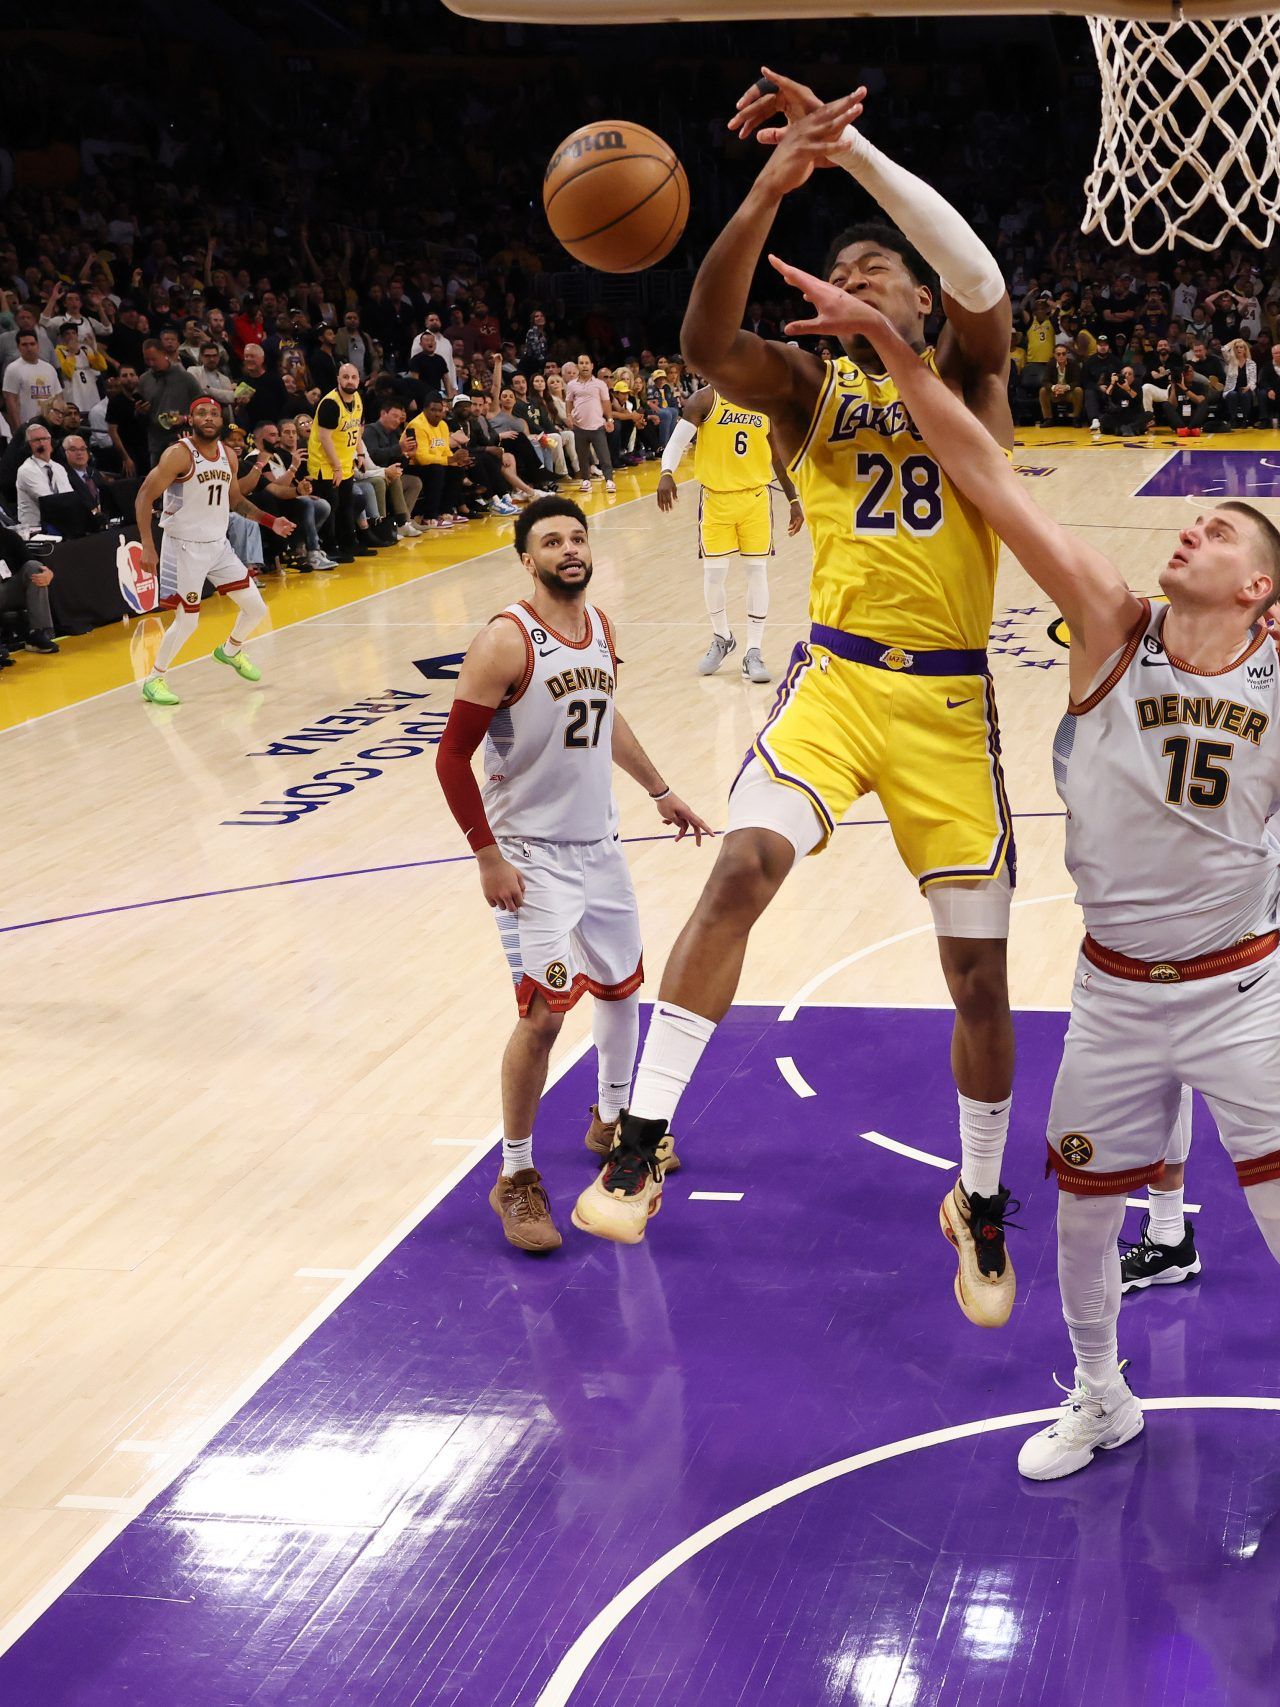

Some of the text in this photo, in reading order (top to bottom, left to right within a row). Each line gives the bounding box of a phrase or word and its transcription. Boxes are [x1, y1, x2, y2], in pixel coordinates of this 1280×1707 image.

[716, 408, 763, 428] LAKERS
[733, 430, 749, 457] 6
[196, 468, 232, 485] DENVER
[207, 483, 223, 506] 11
[855, 452, 944, 537] 28
[534, 630, 544, 644] 6
[1145, 636, 1159, 653] 6
[543, 666, 615, 702] DENVER
[1246, 664, 1274, 679] WU
[1246, 677, 1274, 686] Western
[245, 688, 433, 757] ARENA
[563, 698, 608, 750] 27
[1135, 693, 1270, 746] DENVER
[1161, 735, 1235, 809] 15
